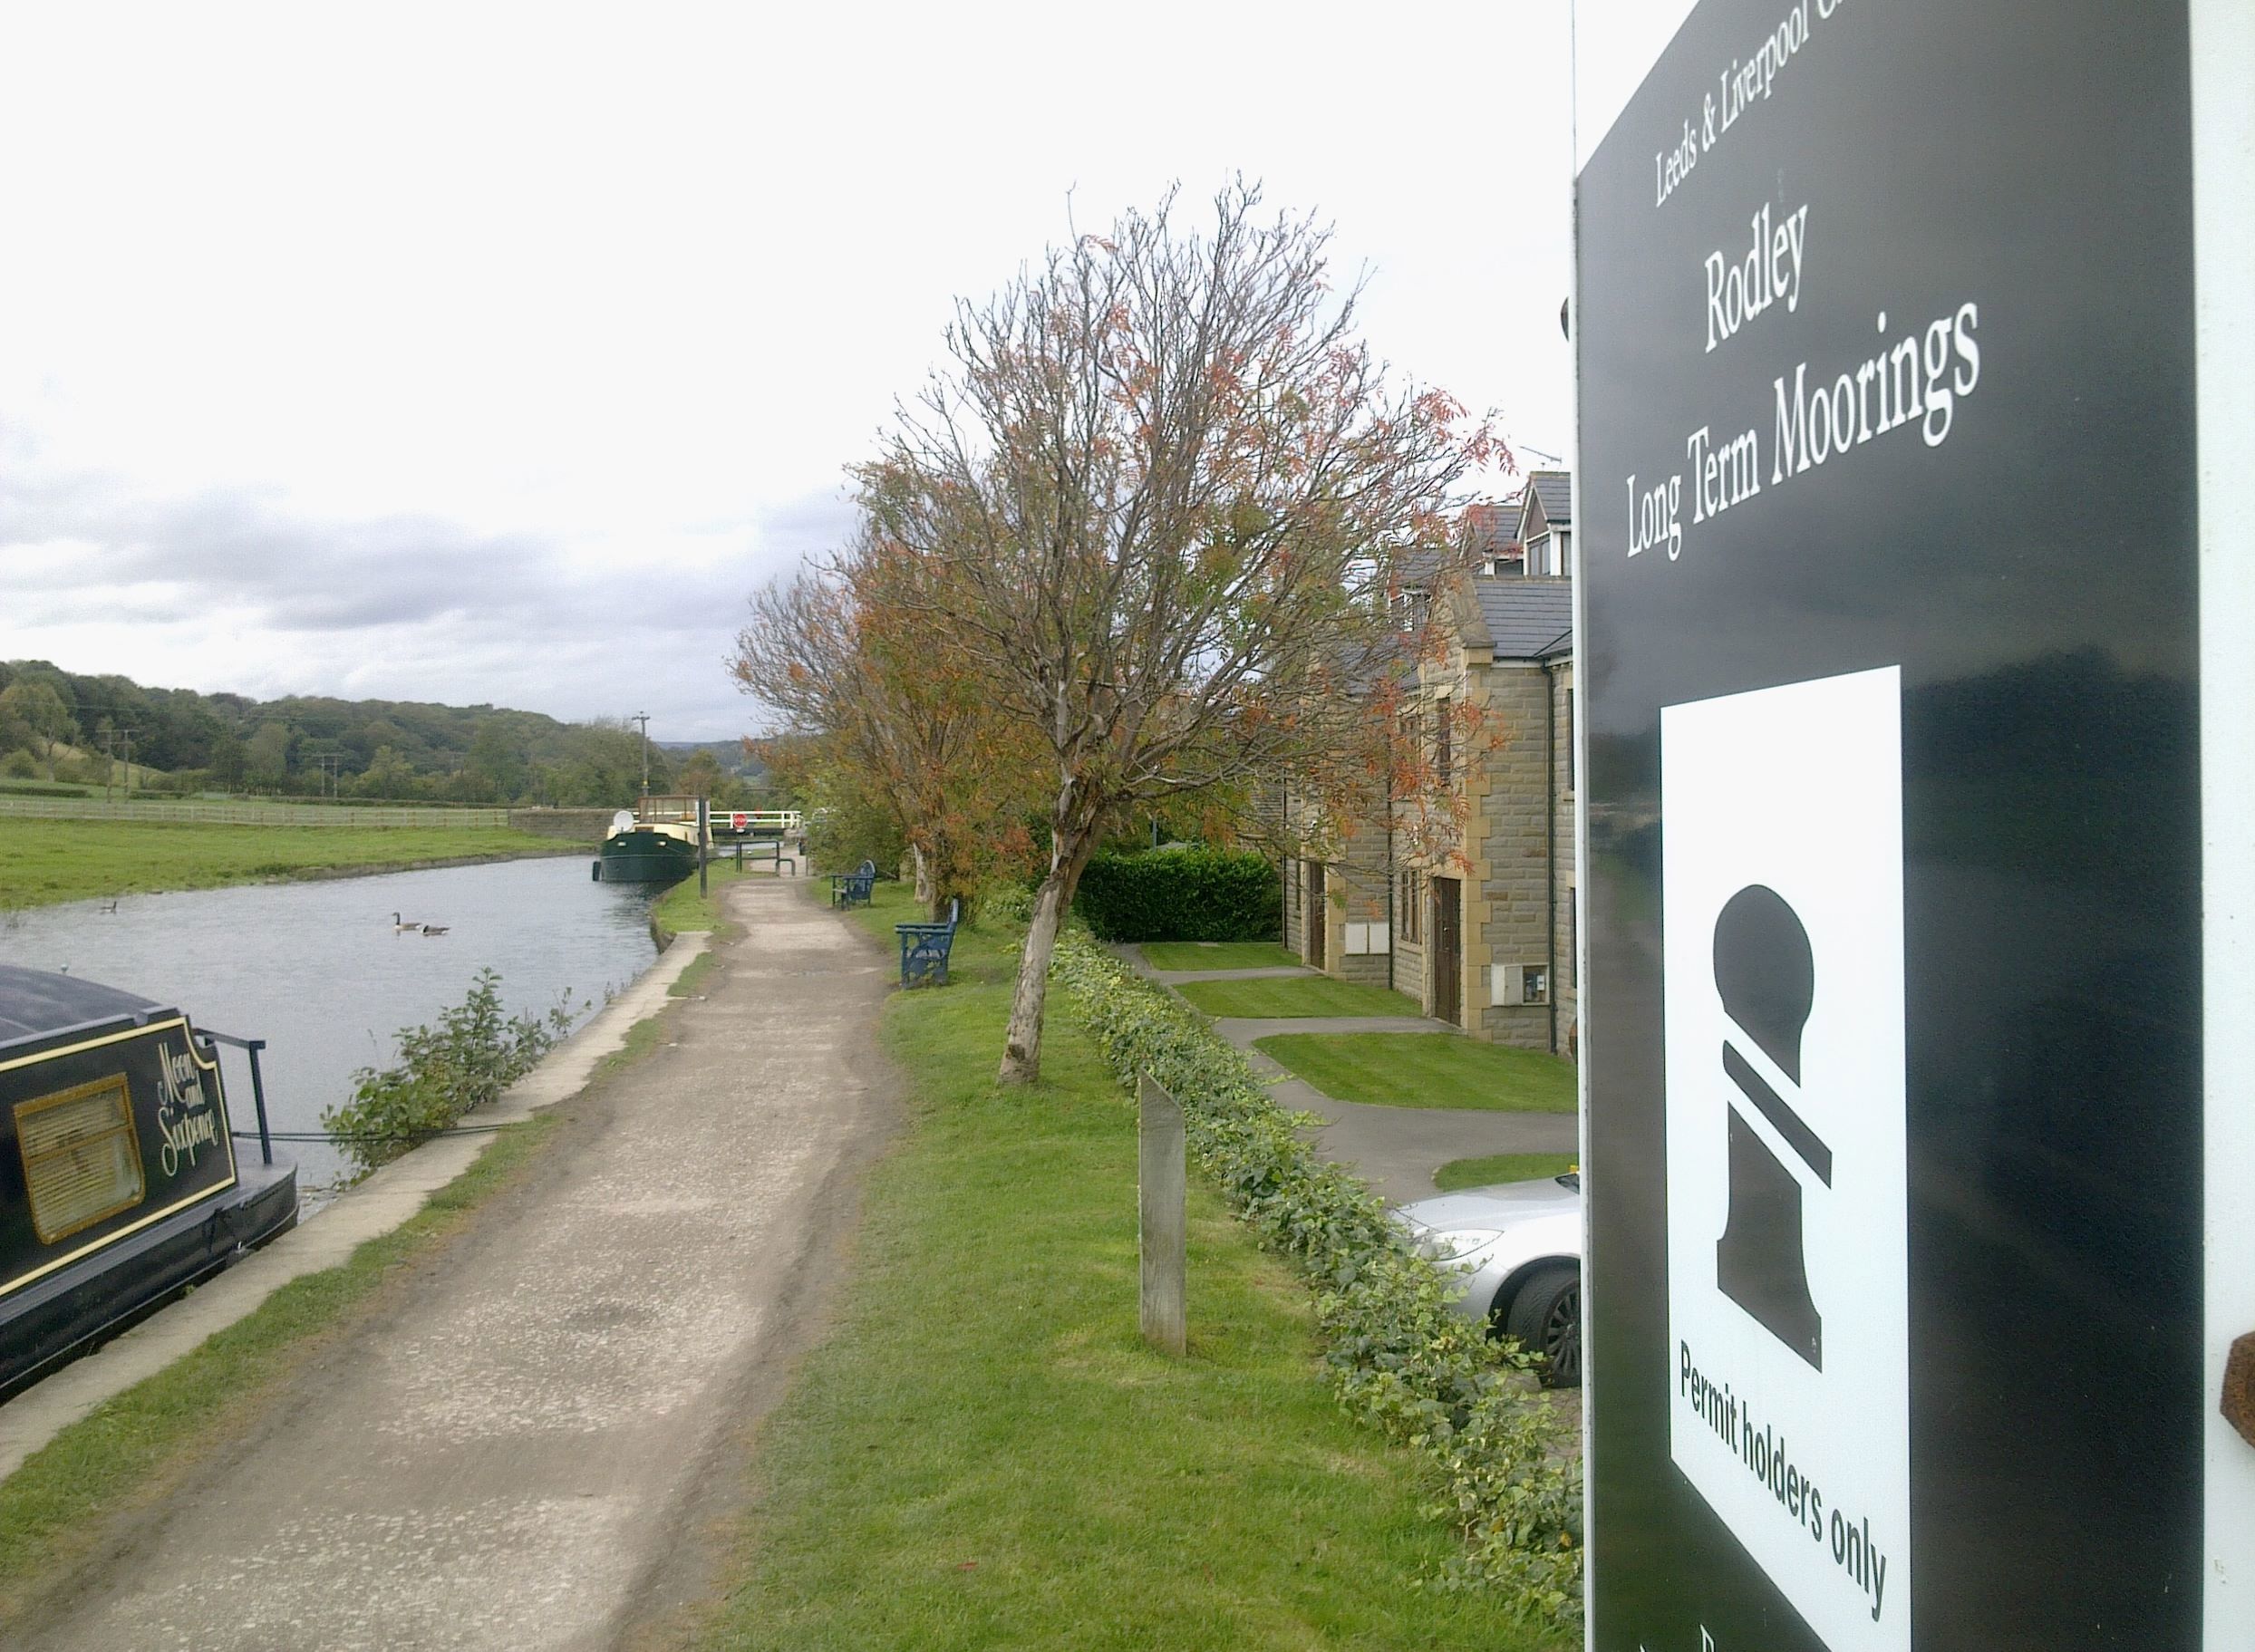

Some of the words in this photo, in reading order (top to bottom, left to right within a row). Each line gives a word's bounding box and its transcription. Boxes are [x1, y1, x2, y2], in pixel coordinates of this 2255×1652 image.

[1655, 119, 1697, 208] Leeds
[1701, 92, 1716, 152] &
[1720, 0, 1810, 134] Liverpool
[1705, 202, 1808, 353] Rodley
[1626, 473, 1682, 562] Long
[1687, 426, 1760, 525] Term
[1771, 302, 1980, 486] Moorings
[1680, 1338, 1738, 1455] Permit
[1742, 1399, 1823, 1543] holders
[1830, 1508, 1887, 1623] only
